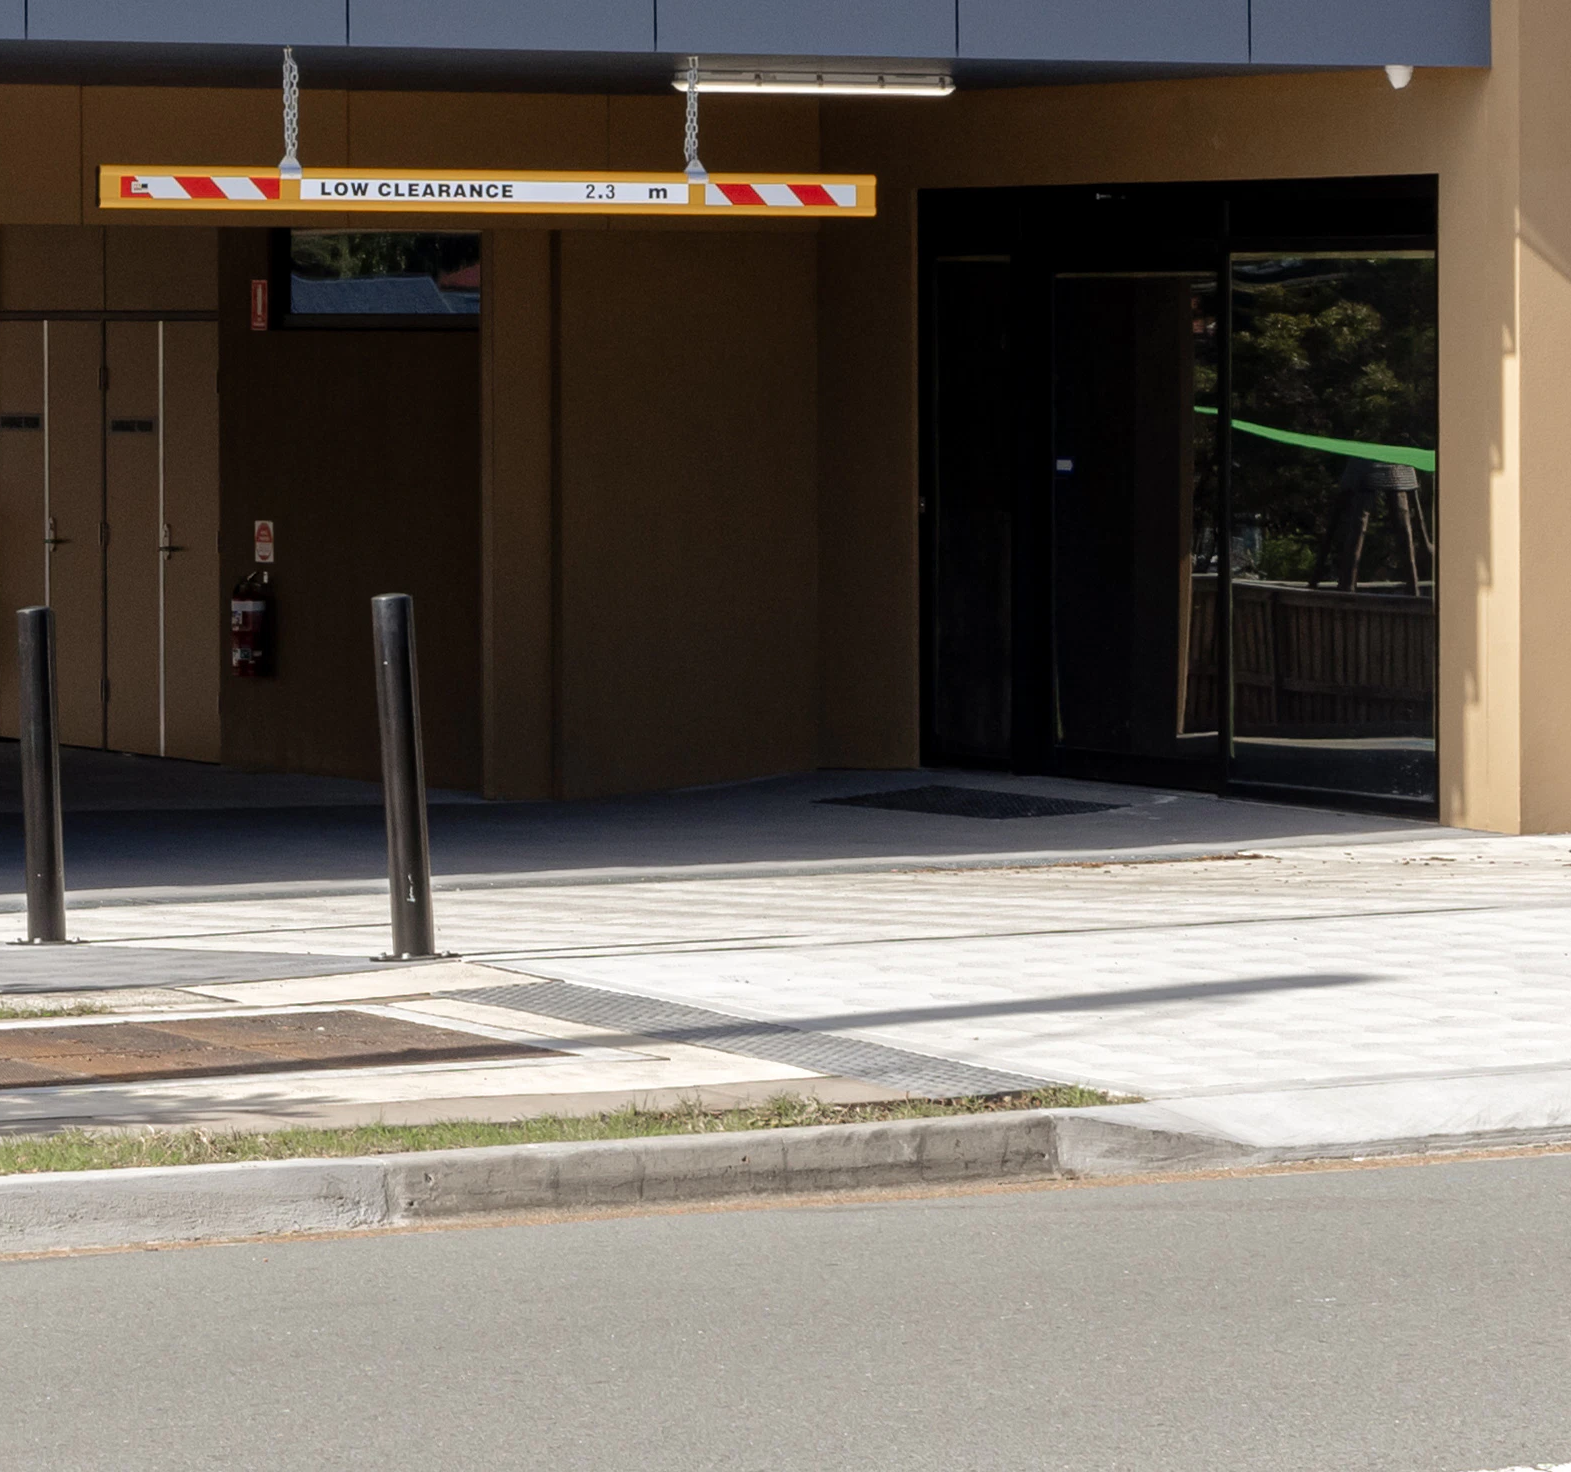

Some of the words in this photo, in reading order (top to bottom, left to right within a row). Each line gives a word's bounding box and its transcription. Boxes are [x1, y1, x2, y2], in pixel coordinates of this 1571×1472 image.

[320, 182, 370, 197] LOW
[377, 183, 515, 199] CLEARANCE
[585, 183, 616, 200] 2.3
[647, 185, 669, 200] m
